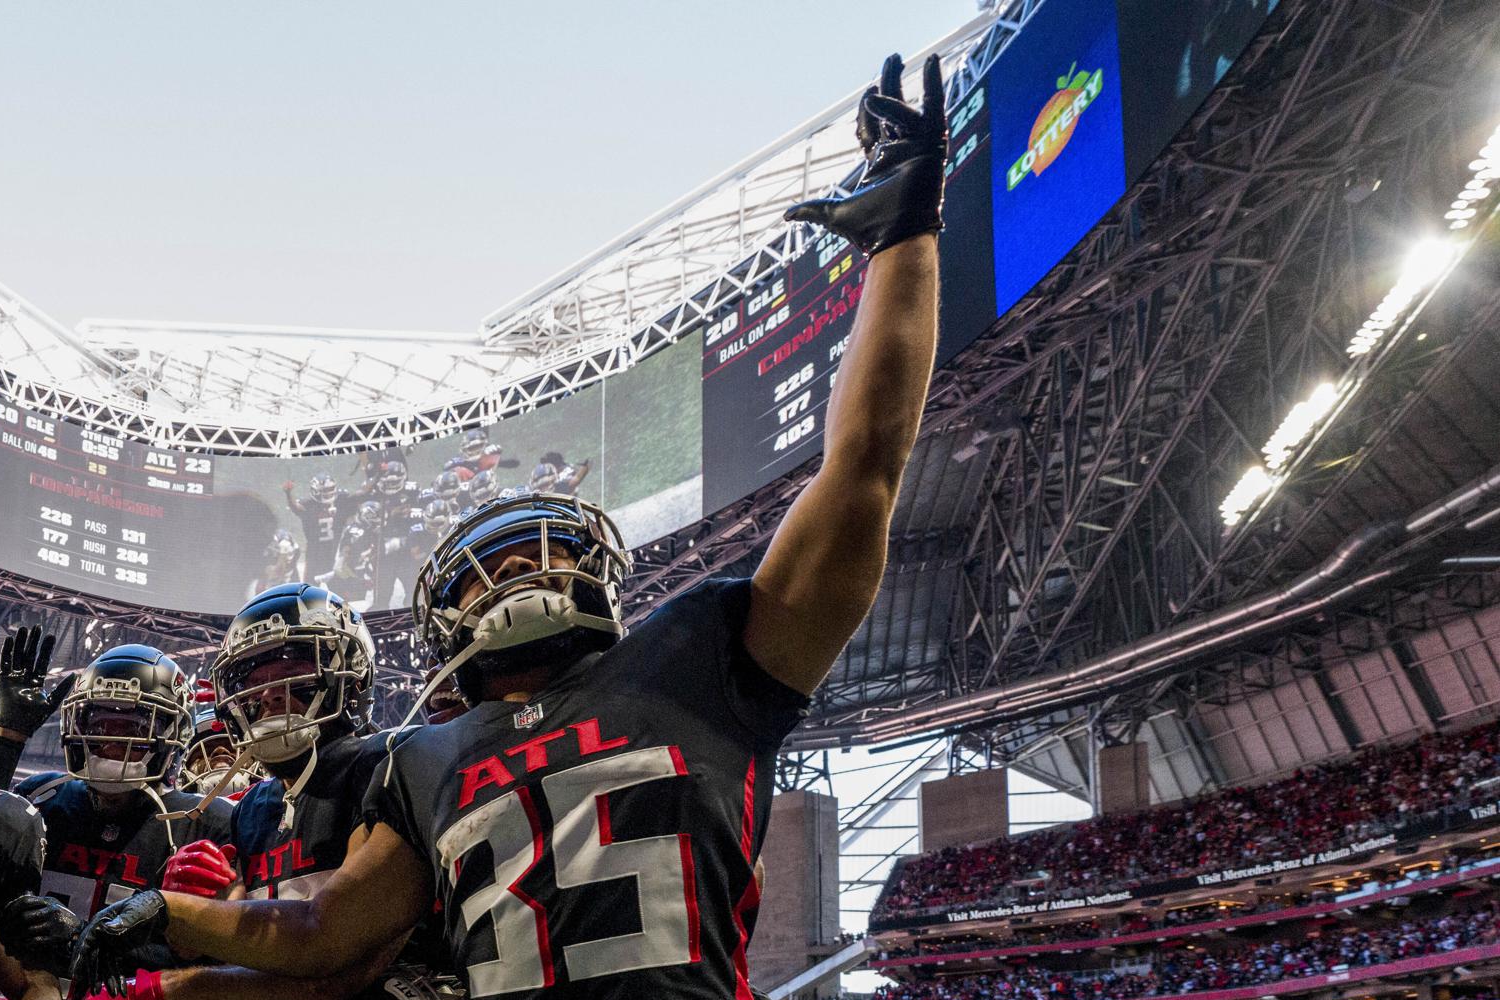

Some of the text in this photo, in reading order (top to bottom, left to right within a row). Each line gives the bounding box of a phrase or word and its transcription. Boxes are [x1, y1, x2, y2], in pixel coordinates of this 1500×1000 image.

[951, 87, 985, 138] 23
[1009, 73, 1100, 187] LOTTERY
[829, 254, 853, 284] 25
[706, 278, 785, 346] 20 CLE
[719, 304, 791, 364] BALL ON 46
[774, 362, 815, 403] 226
[778, 390, 811, 425] 177
[26, 415, 56, 437] CLE
[774, 415, 815, 451] 403
[2, 432, 23, 449] BALL
[24, 441, 37, 455] ON
[81, 439, 119, 461] 0:55
[88, 461, 108, 476] 25
[145, 451, 211, 474] ATL 23
[172, 483, 185, 492] AND
[186, 483, 204, 495] 23
[40, 506, 147, 545] 226 PASS 131
[42, 527, 148, 565] 177 RUSH 204
[80, 559, 107, 576] TOTAL
[246, 623, 271, 638] ATL
[106, 681, 129, 690] ATL
[457, 716, 629, 810] ATL
[58, 841, 148, 888] ATL
[244, 838, 316, 884] ATL
[1196, 872, 1222, 885] Visit
[1223, 859, 1301, 882] Mercedes-Benz
[1302, 854, 1315, 866] of
[948, 911, 968, 923] Visit
[969, 904, 1037, 920] Mercedes-Benz
[1037, 901, 1049, 912] of
[1049, 897, 1086, 910] Atlanta
